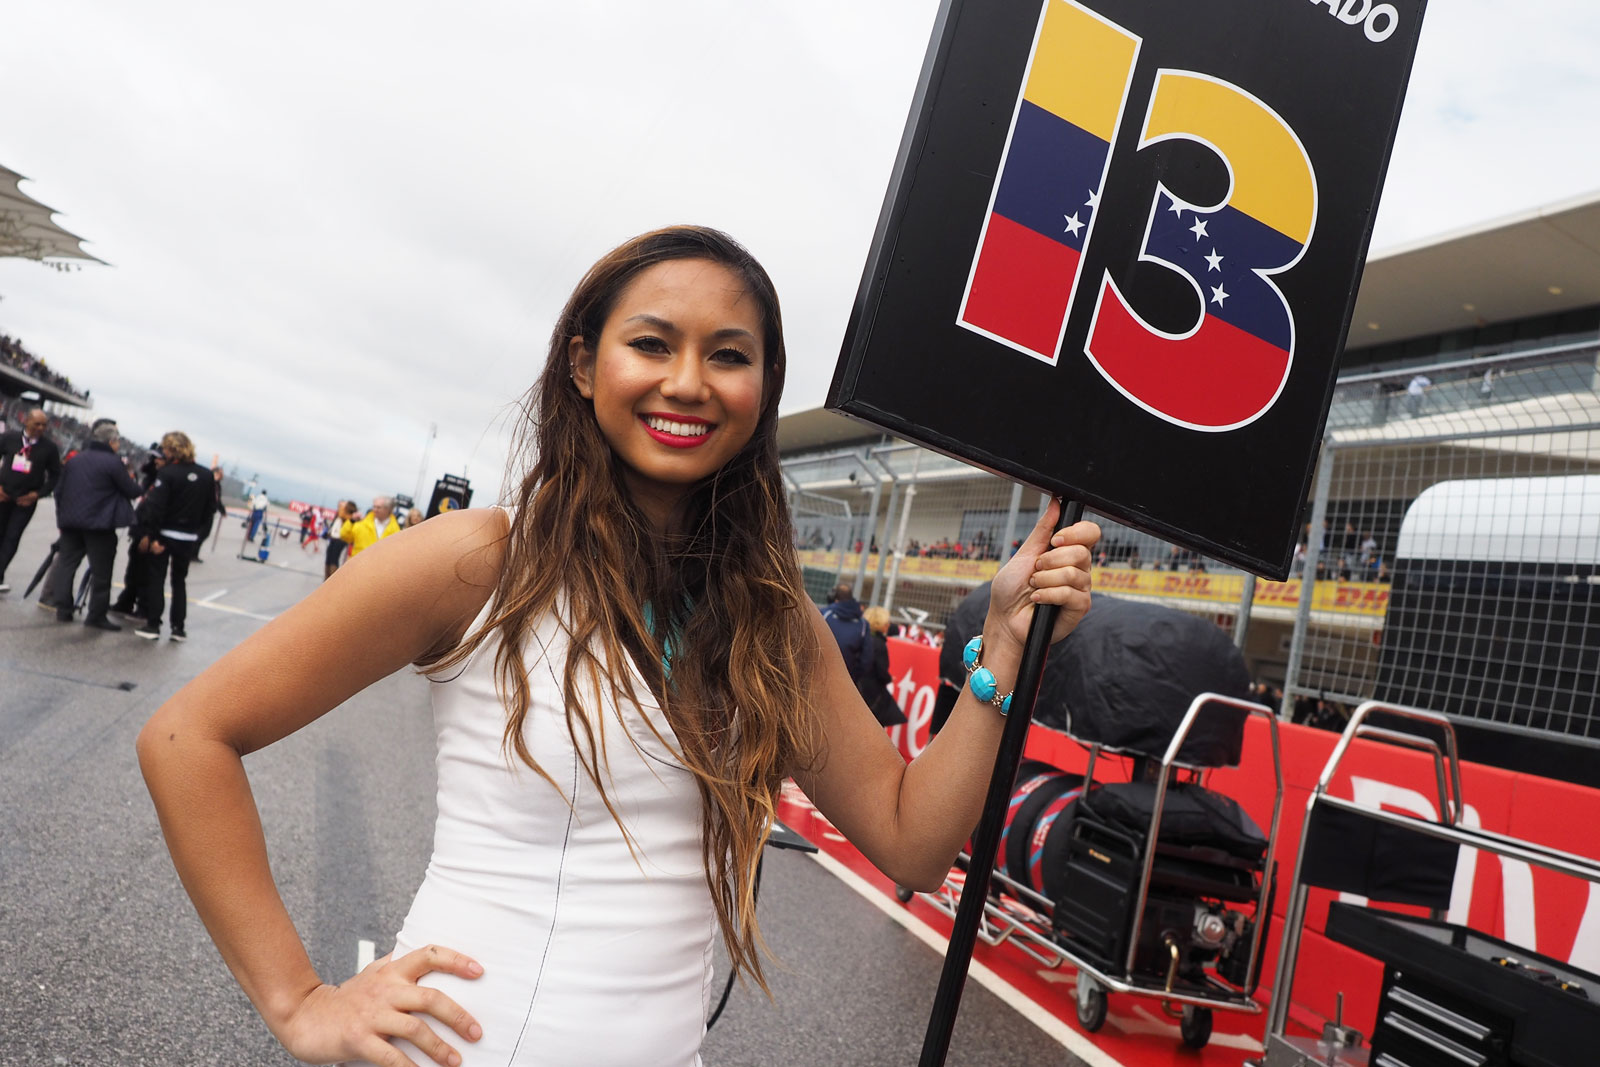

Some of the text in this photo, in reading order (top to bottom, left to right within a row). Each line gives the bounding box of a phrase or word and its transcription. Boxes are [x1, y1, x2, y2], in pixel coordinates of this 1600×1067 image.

[956, 0, 1319, 432] 13
[1097, 571, 1140, 589] DHL
[1162, 575, 1213, 596] DHL
[1335, 587, 1388, 610] DH
